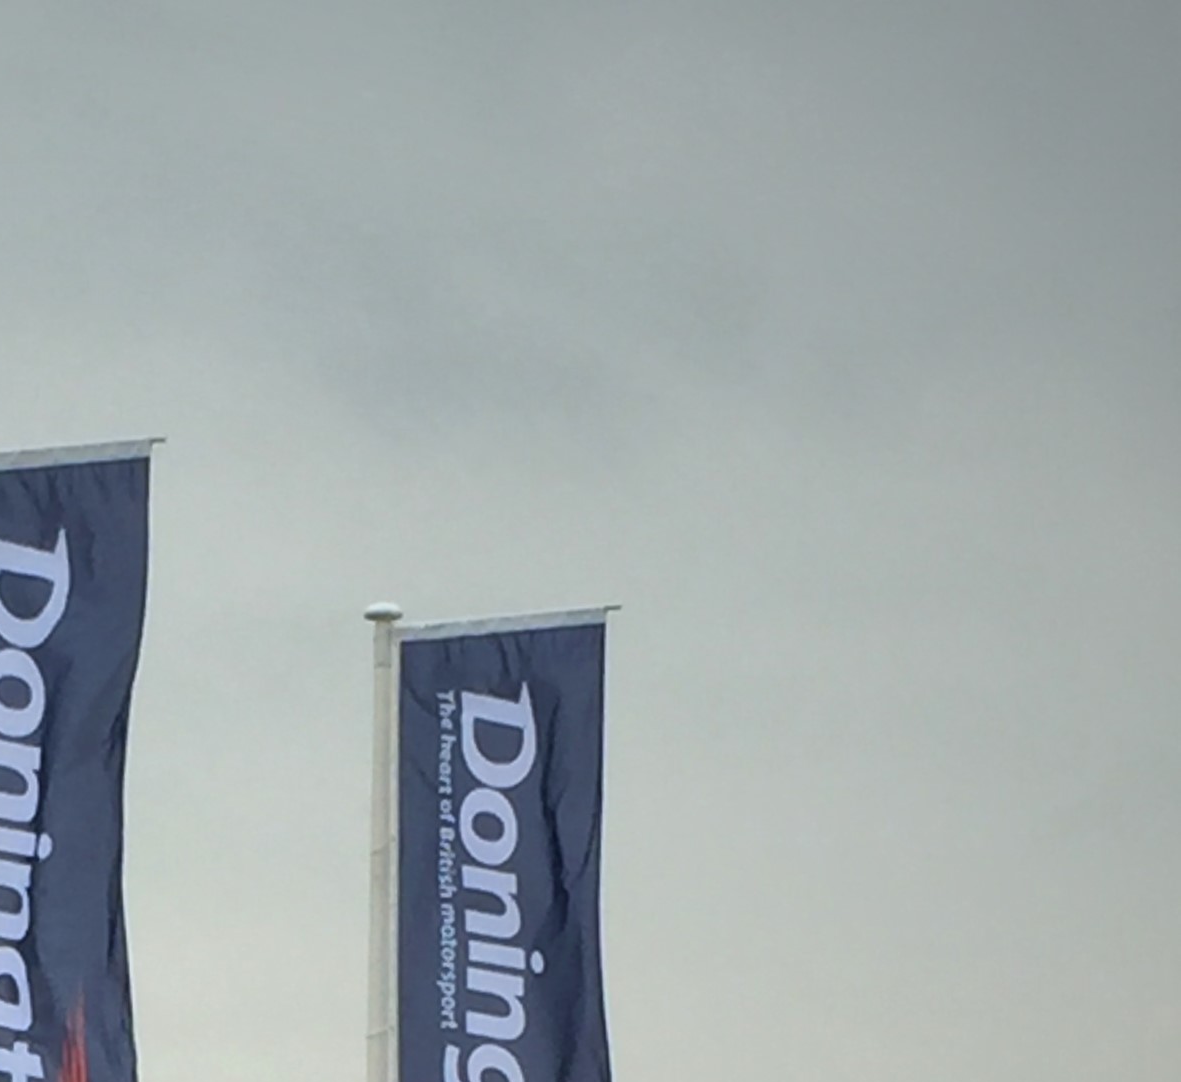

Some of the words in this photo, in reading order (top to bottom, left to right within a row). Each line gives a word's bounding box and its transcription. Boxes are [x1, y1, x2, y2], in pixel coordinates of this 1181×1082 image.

[437, 690, 455, 730] The
[438, 732, 456, 793] heart
[439, 795, 455, 824] of
[439, 828, 457, 899] British
[438, 903, 457, 1030] motorsport
